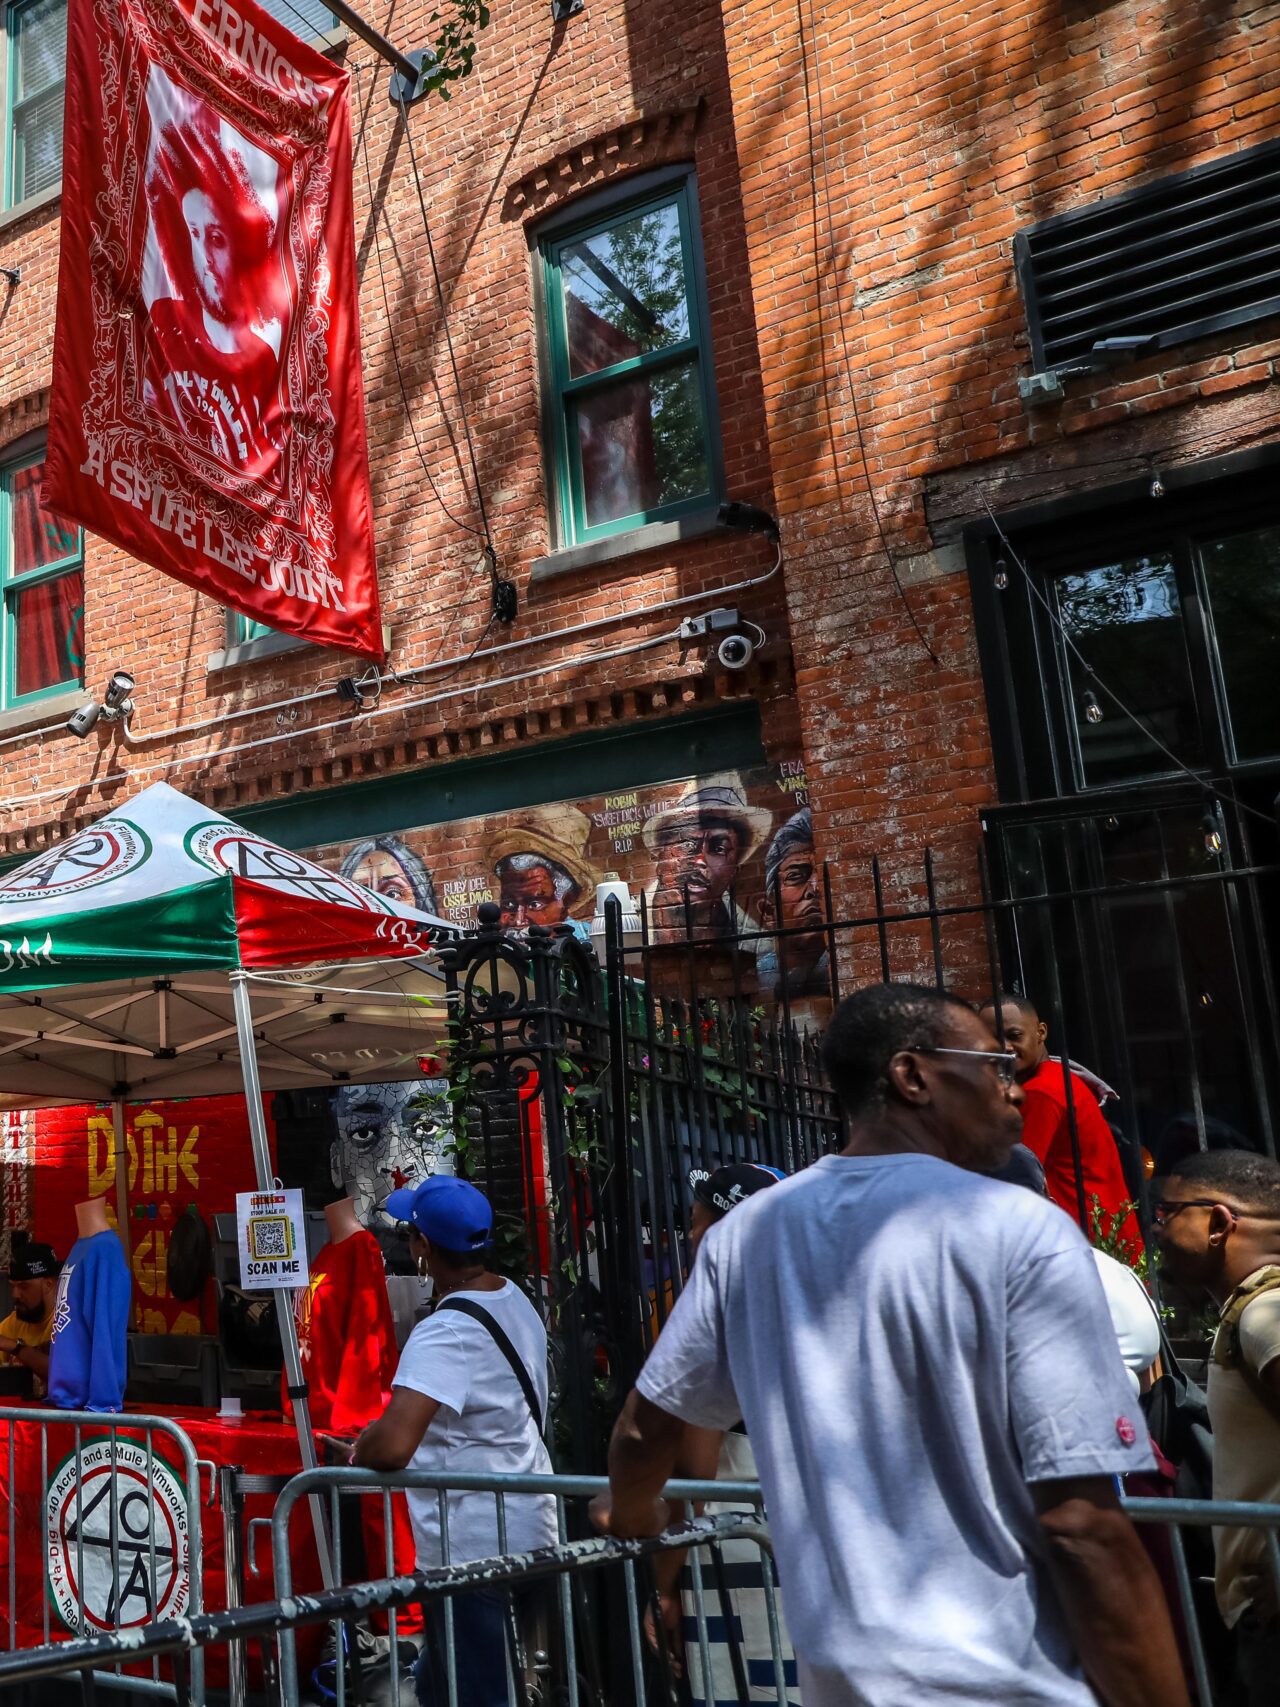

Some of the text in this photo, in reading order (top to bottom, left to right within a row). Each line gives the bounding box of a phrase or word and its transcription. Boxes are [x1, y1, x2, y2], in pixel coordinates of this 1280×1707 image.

[80, 440, 108, 486] A
[203, 517, 257, 584] LEE
[260, 556, 347, 613] JOINT
[605, 793, 638, 810] ROBIN
[621, 807, 642, 822] DICK
[608, 821, 641, 840] HARRIS
[444, 877, 487, 896] RUBY DEE
[443, 889, 493, 908] OSSIE DAVIS
[449, 905, 474, 920] REST
[133, 1109, 200, 1194] THE
[247, 1261, 300, 1275] SCAN ME
[83, 1448, 103, 1467] and
[116, 1447, 144, 1467] Mule
